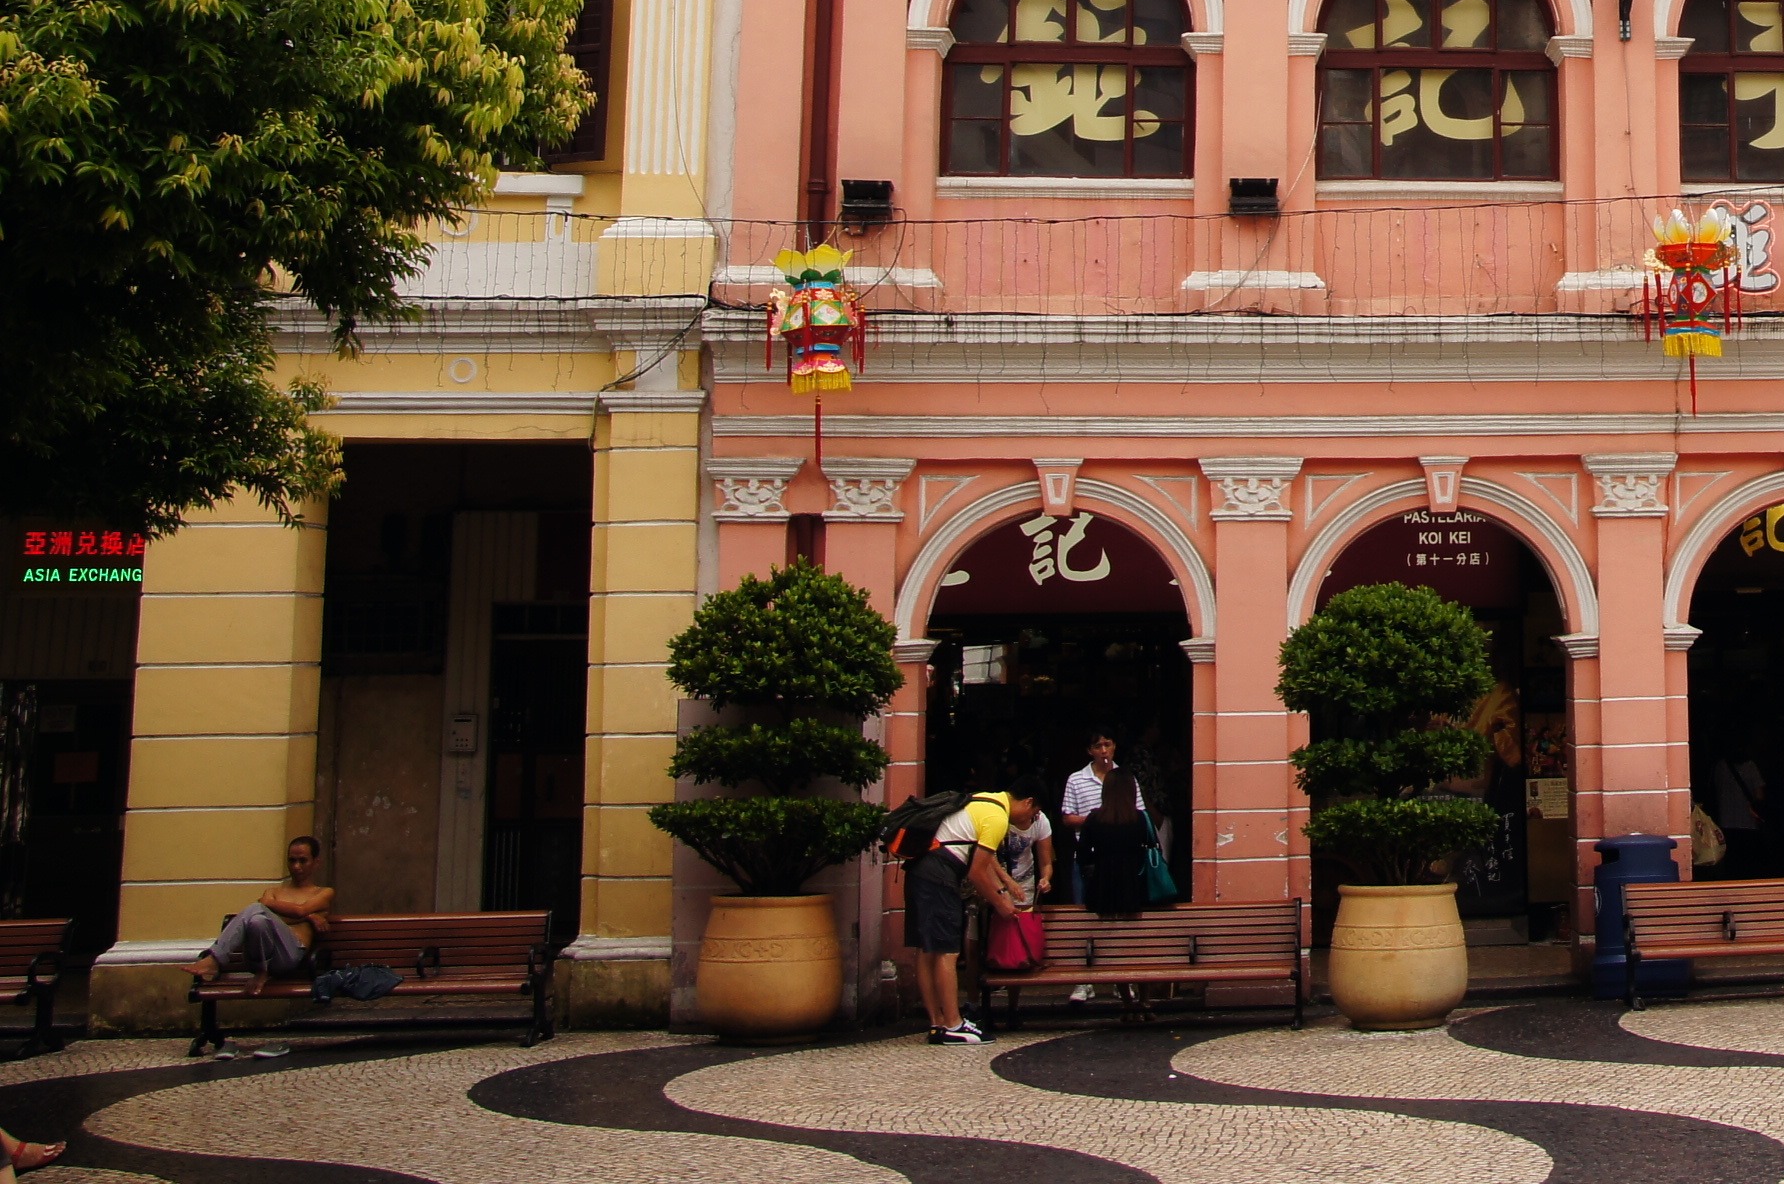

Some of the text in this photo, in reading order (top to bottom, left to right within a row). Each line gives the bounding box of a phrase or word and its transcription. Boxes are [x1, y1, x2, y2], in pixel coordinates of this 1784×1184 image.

[1418, 531, 1471, 545] KOI KEI
[23, 568, 61, 582] ASIA
